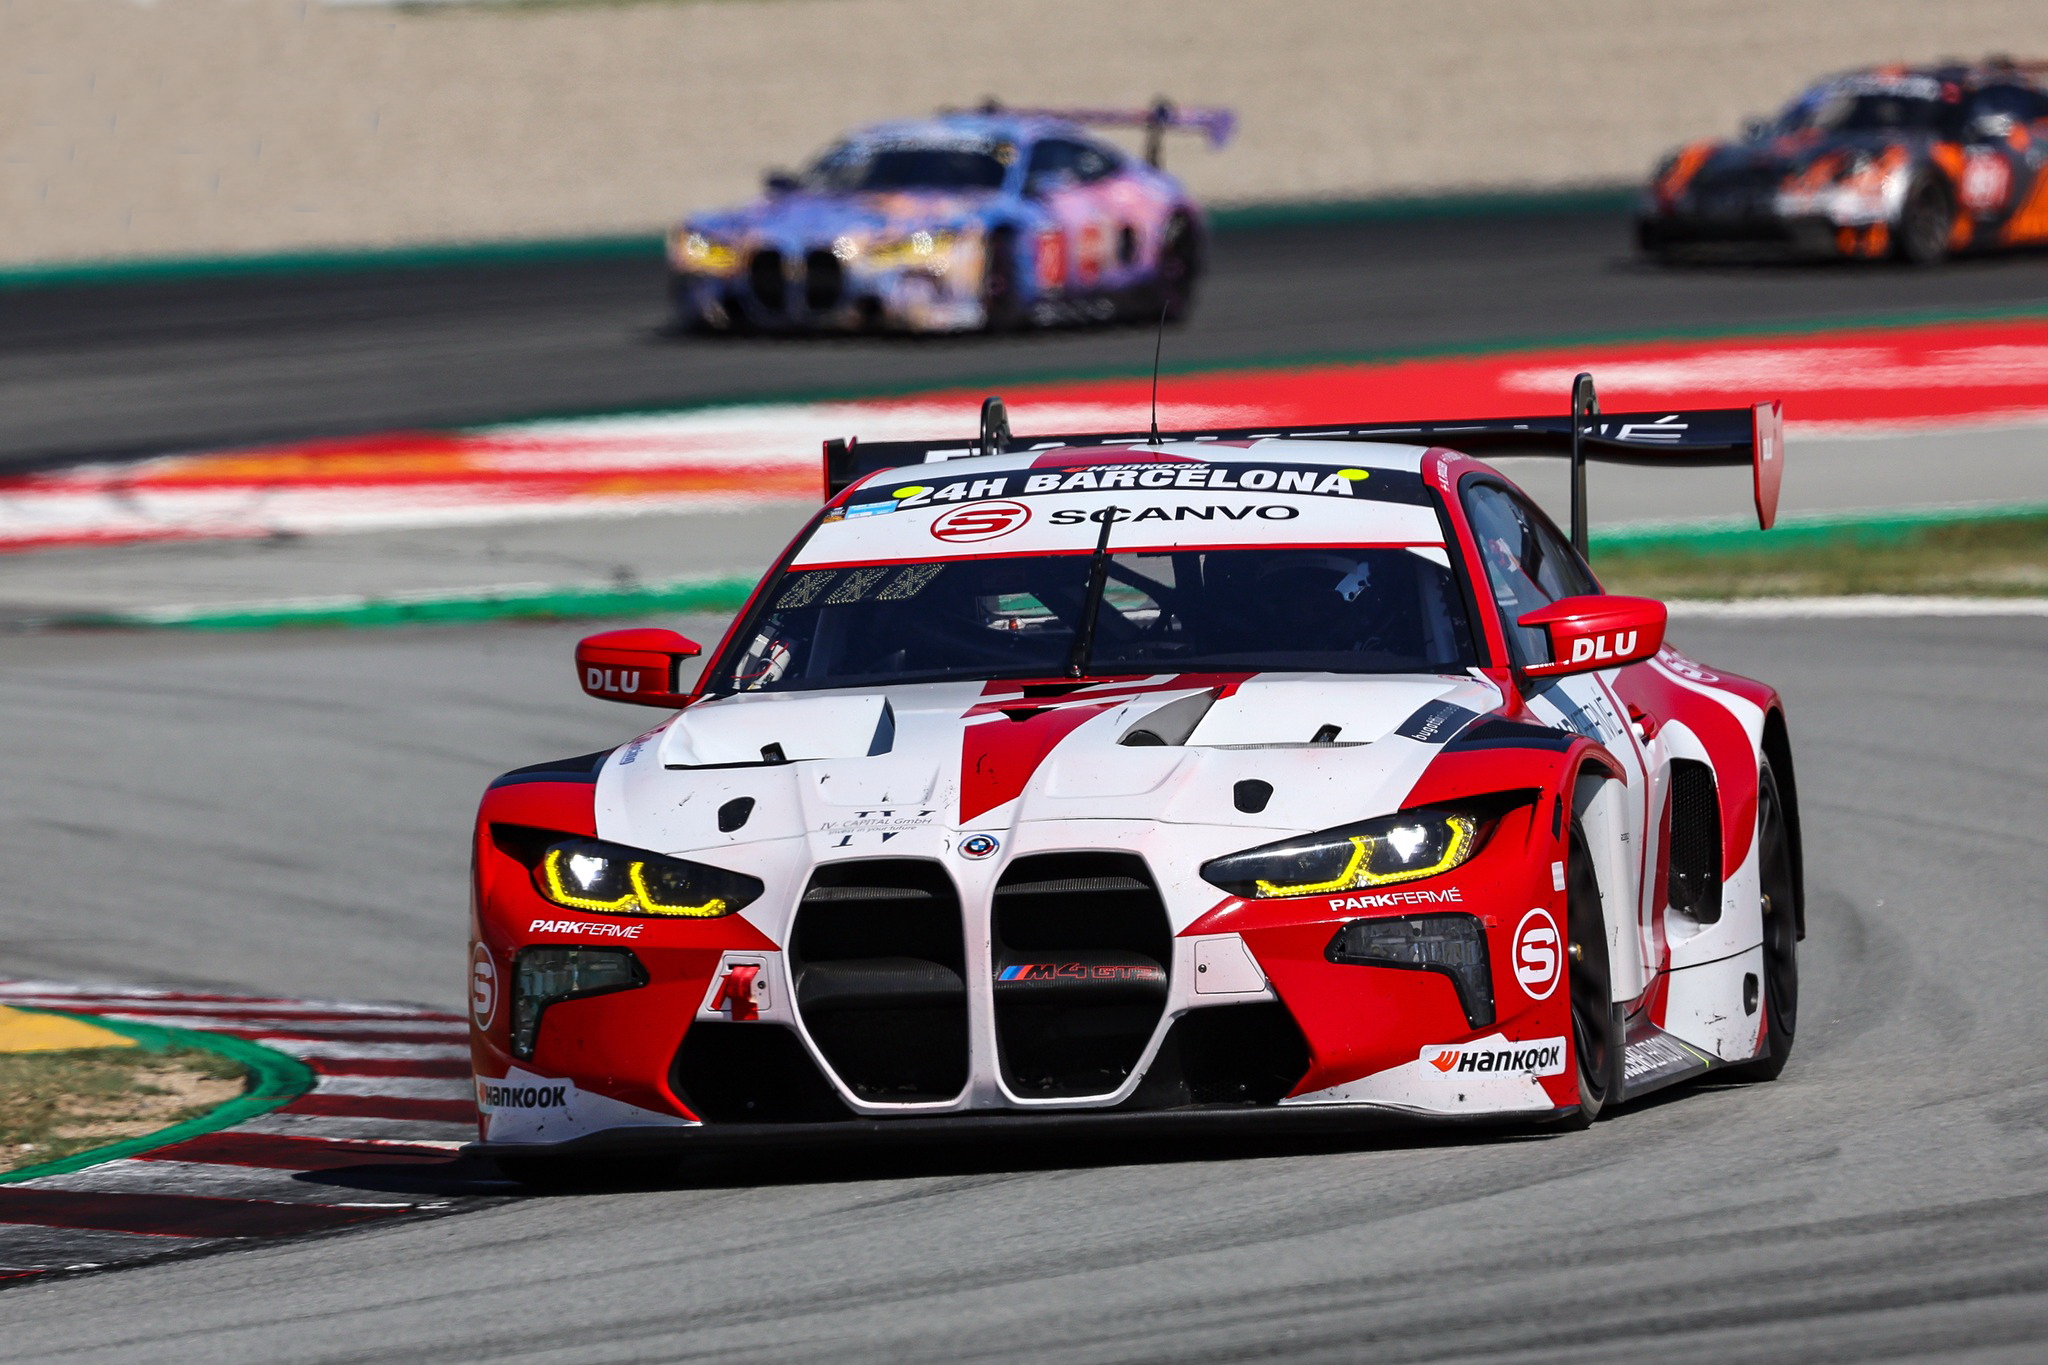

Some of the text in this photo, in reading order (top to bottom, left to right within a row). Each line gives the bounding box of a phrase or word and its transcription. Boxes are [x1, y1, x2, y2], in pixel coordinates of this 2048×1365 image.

[897, 468, 1354, 508] 24H BARCELONA
[1048, 505, 1300, 525] SCANVO
[1571, 630, 1637, 663] DLU
[587, 667, 640, 694] DLU
[842, 818, 890, 827] CAPITAL
[894, 817, 932, 825] GmbH
[1328, 886, 1463, 911] PARKFERMÉ
[528, 919, 644, 939] PARKFERMÉ
